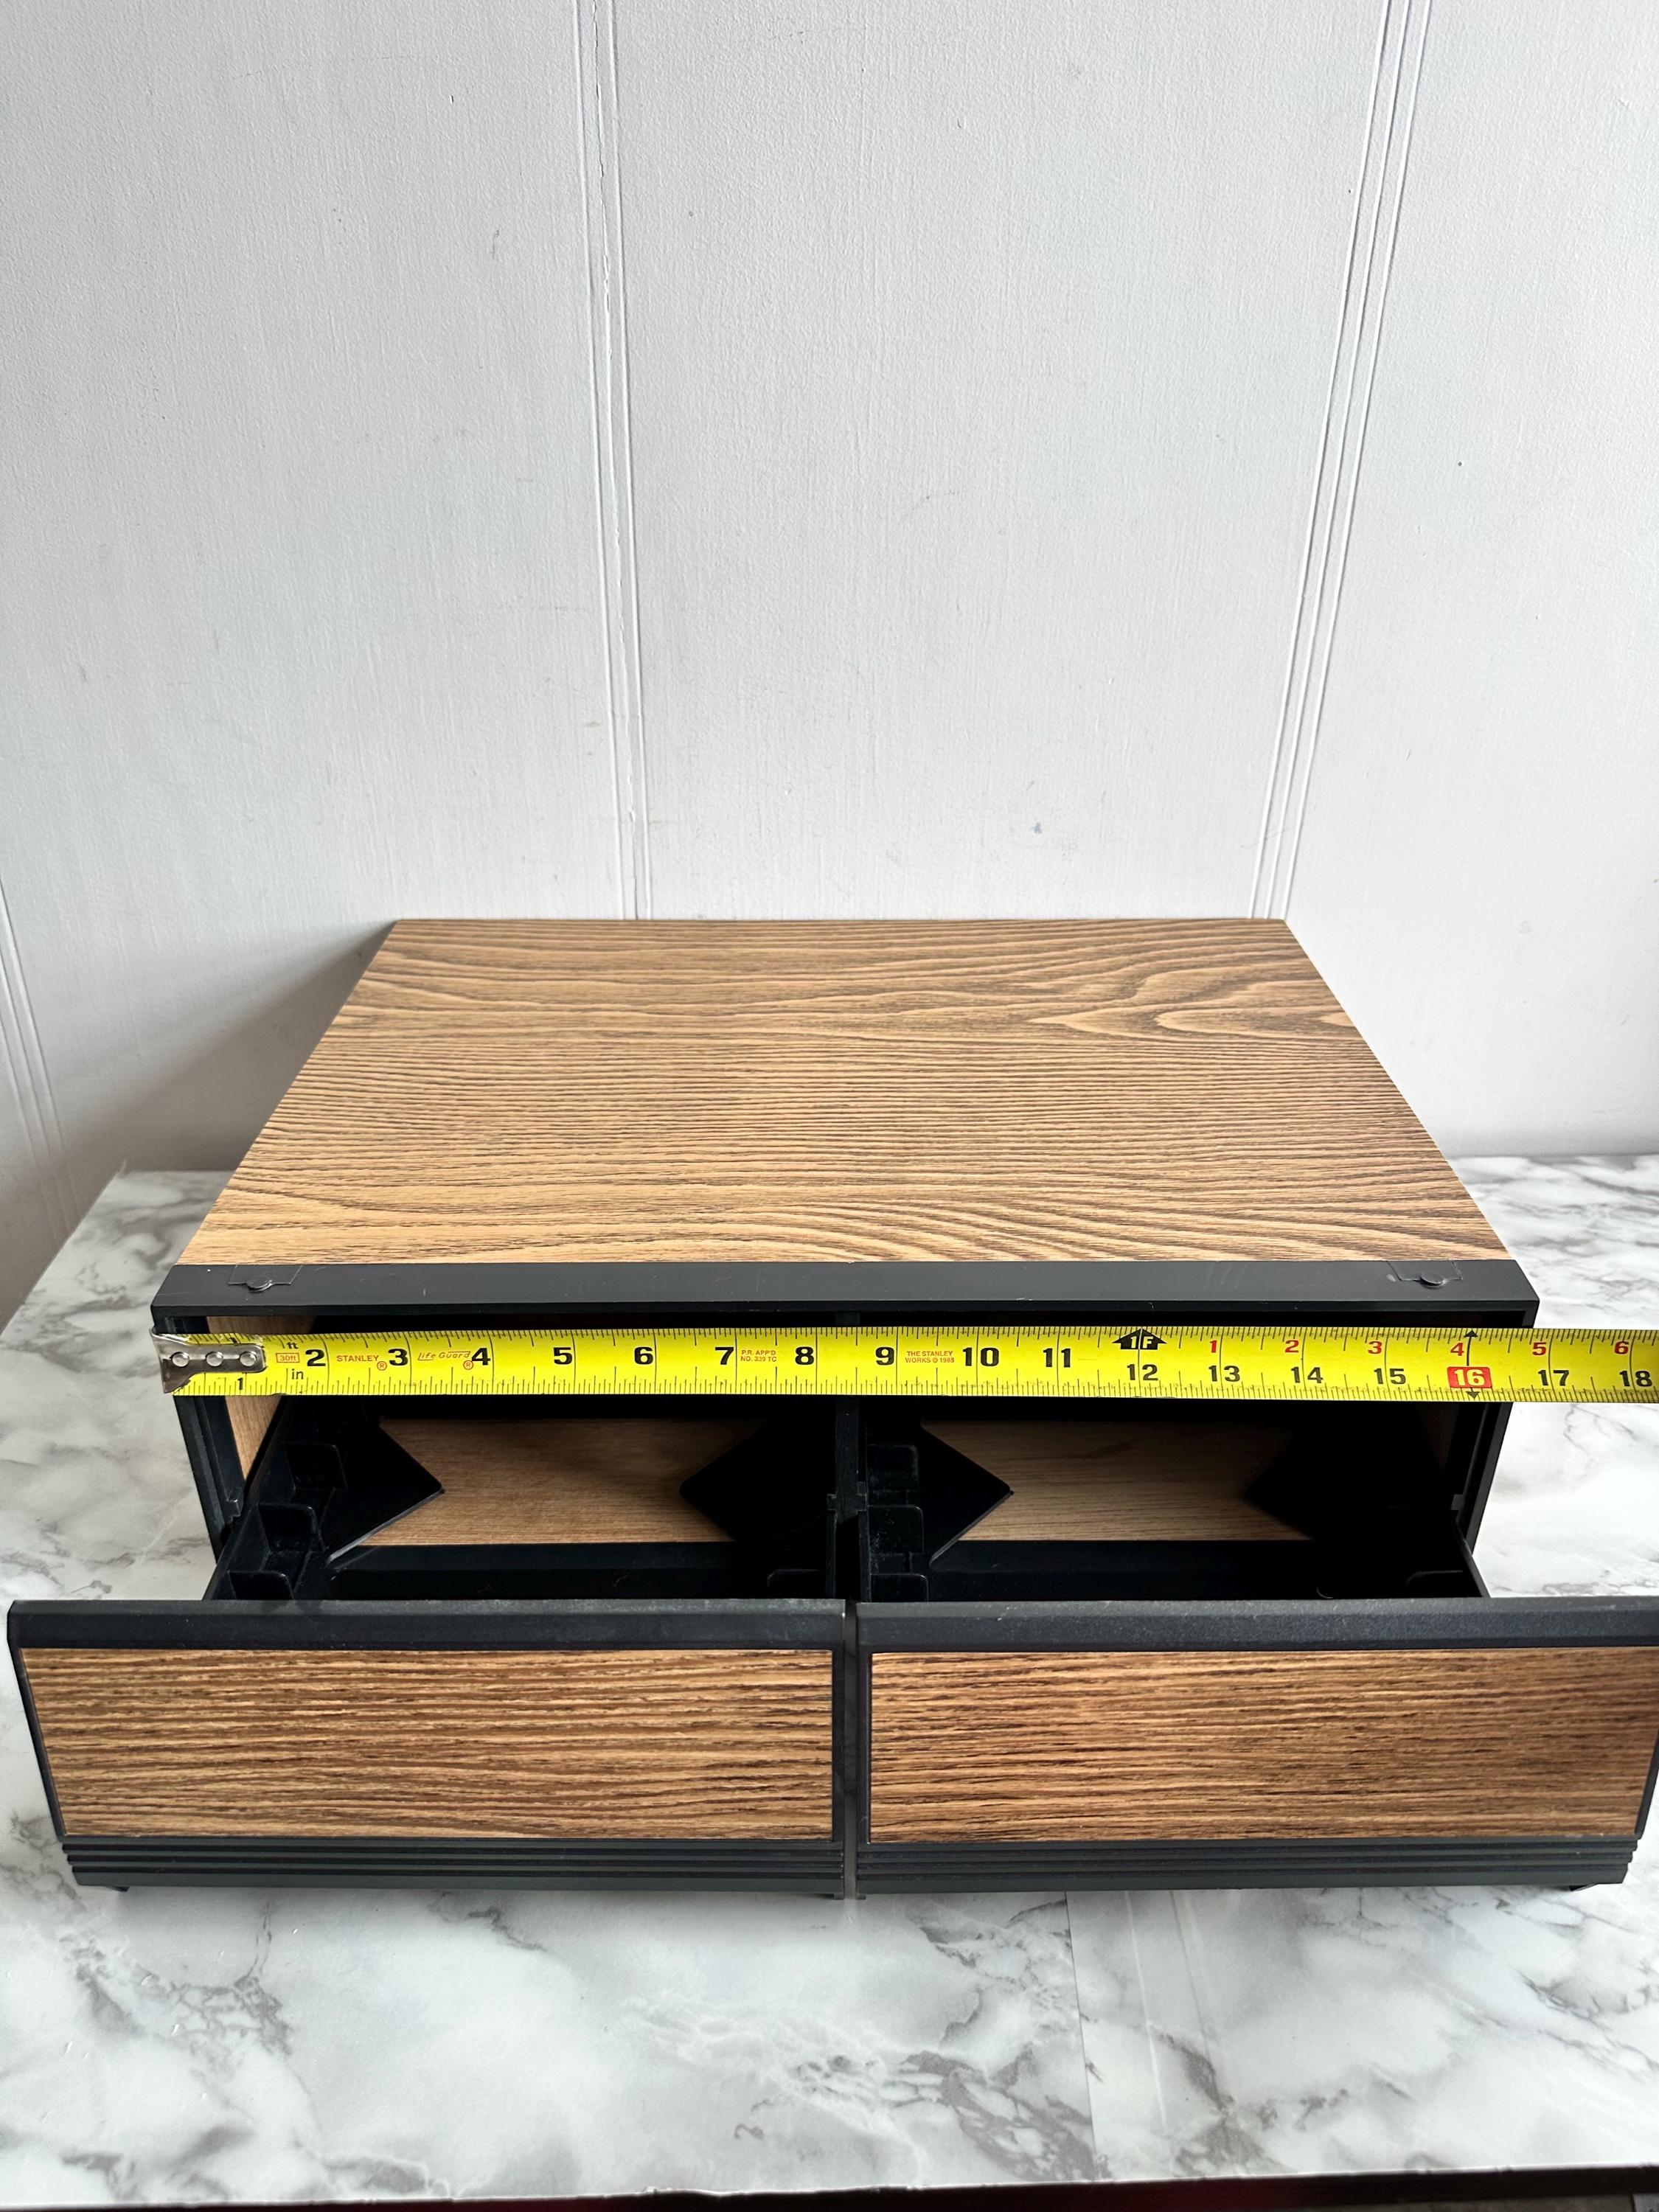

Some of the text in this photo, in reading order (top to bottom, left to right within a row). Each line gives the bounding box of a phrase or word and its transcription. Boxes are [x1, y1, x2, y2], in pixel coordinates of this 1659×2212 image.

[417, 1351, 471, 1361] Life Guard
[1210, 1340, 1629, 1356] 1 2 3 4 5 6
[305, 1346, 1071, 1368] 2 3 4 5 6 7 8 9 10 11
[237, 1364, 1653, 1391] 1 12 13 14 15 16 17 18
[292, 1368, 304, 1380] in
